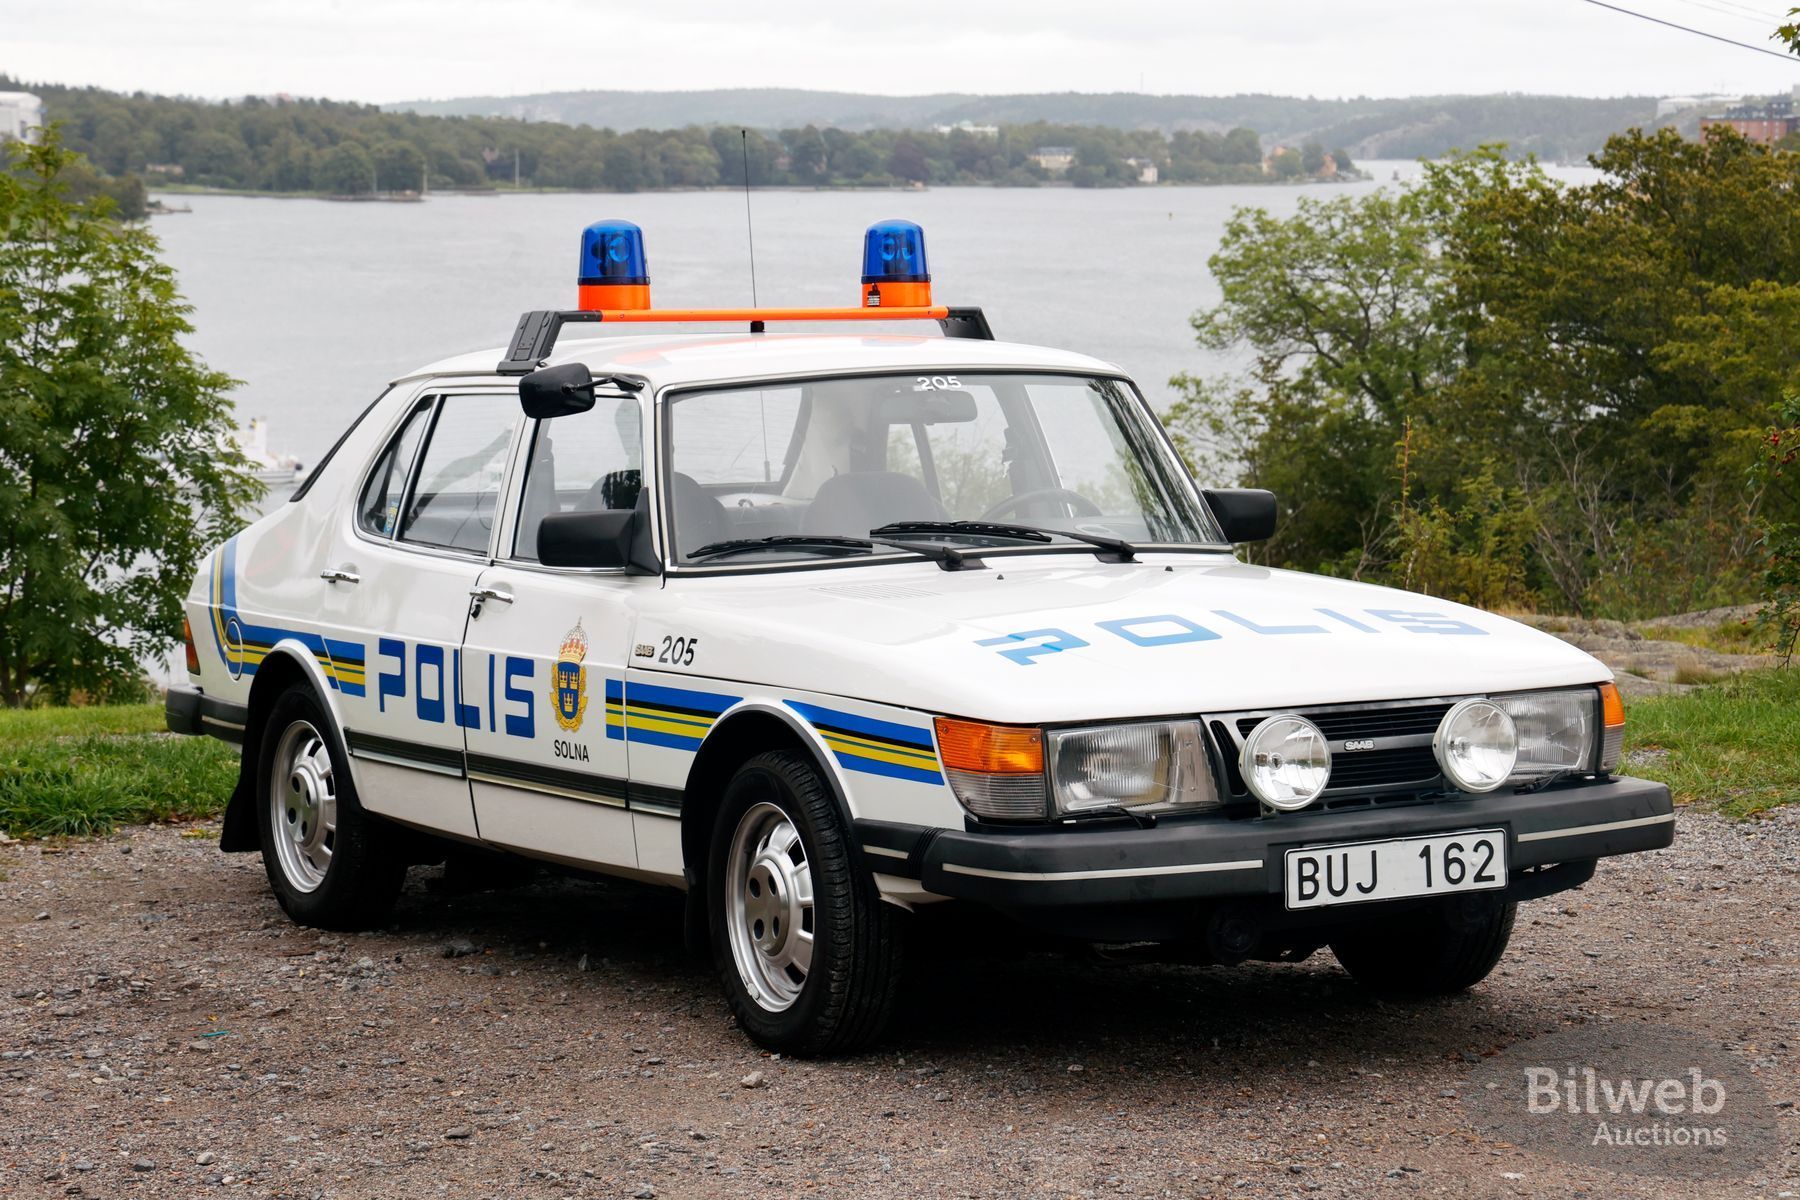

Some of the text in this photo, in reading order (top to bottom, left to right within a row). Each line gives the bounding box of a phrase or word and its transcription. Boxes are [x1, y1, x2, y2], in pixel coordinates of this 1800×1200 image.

[916, 375, 962, 391] 205
[658, 635, 698, 666] 205
[973, 607, 1491, 666] POLIS
[378, 637, 536, 738] POLIS
[553, 739, 590, 763] SOLNA
[1344, 740, 1375, 751] SAAB
[1297, 839, 1496, 901] BUJ 162
